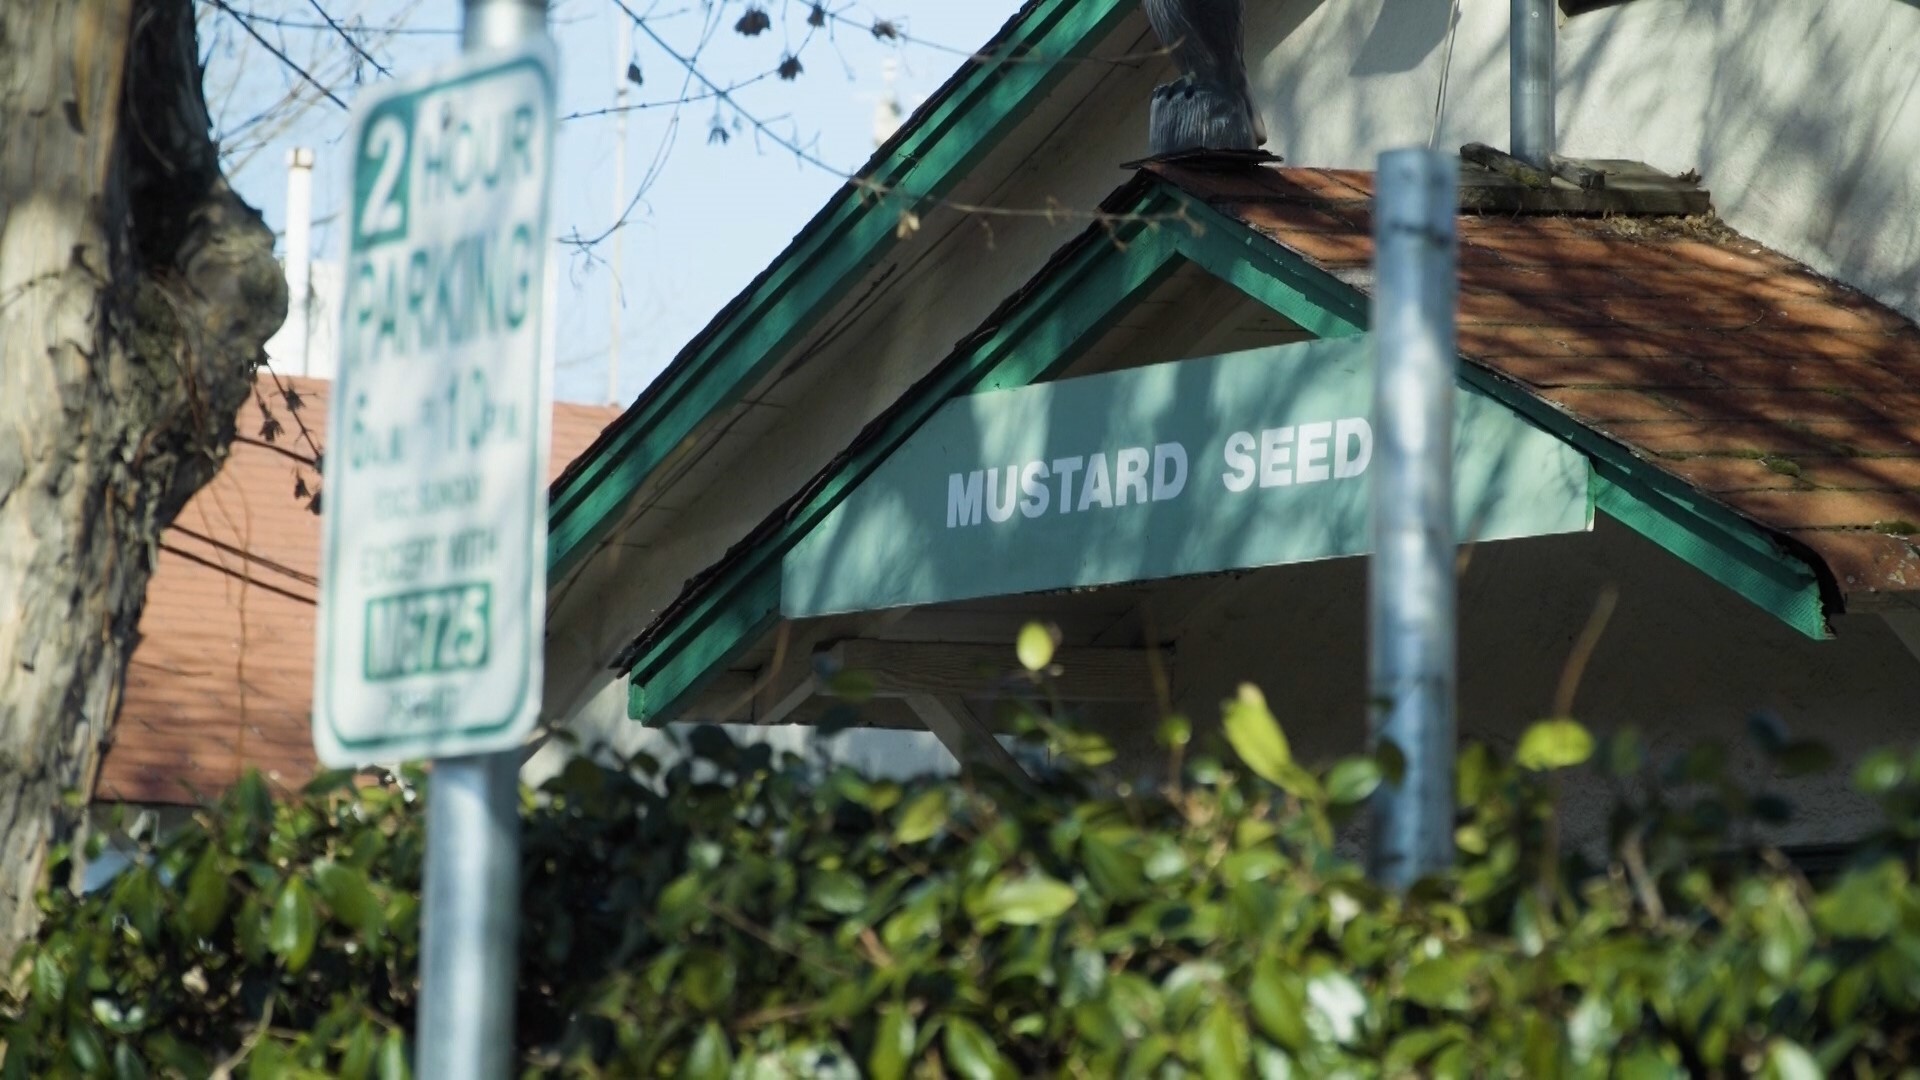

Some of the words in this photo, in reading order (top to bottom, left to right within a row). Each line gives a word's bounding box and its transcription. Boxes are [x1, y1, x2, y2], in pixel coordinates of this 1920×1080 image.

[359, 112, 407, 237] 2
[420, 103, 534, 205] HOUR
[351, 222, 532, 360] PARKING
[946, 441, 1189, 528] MUSTARD
[1222, 416, 1374, 493] SEED
